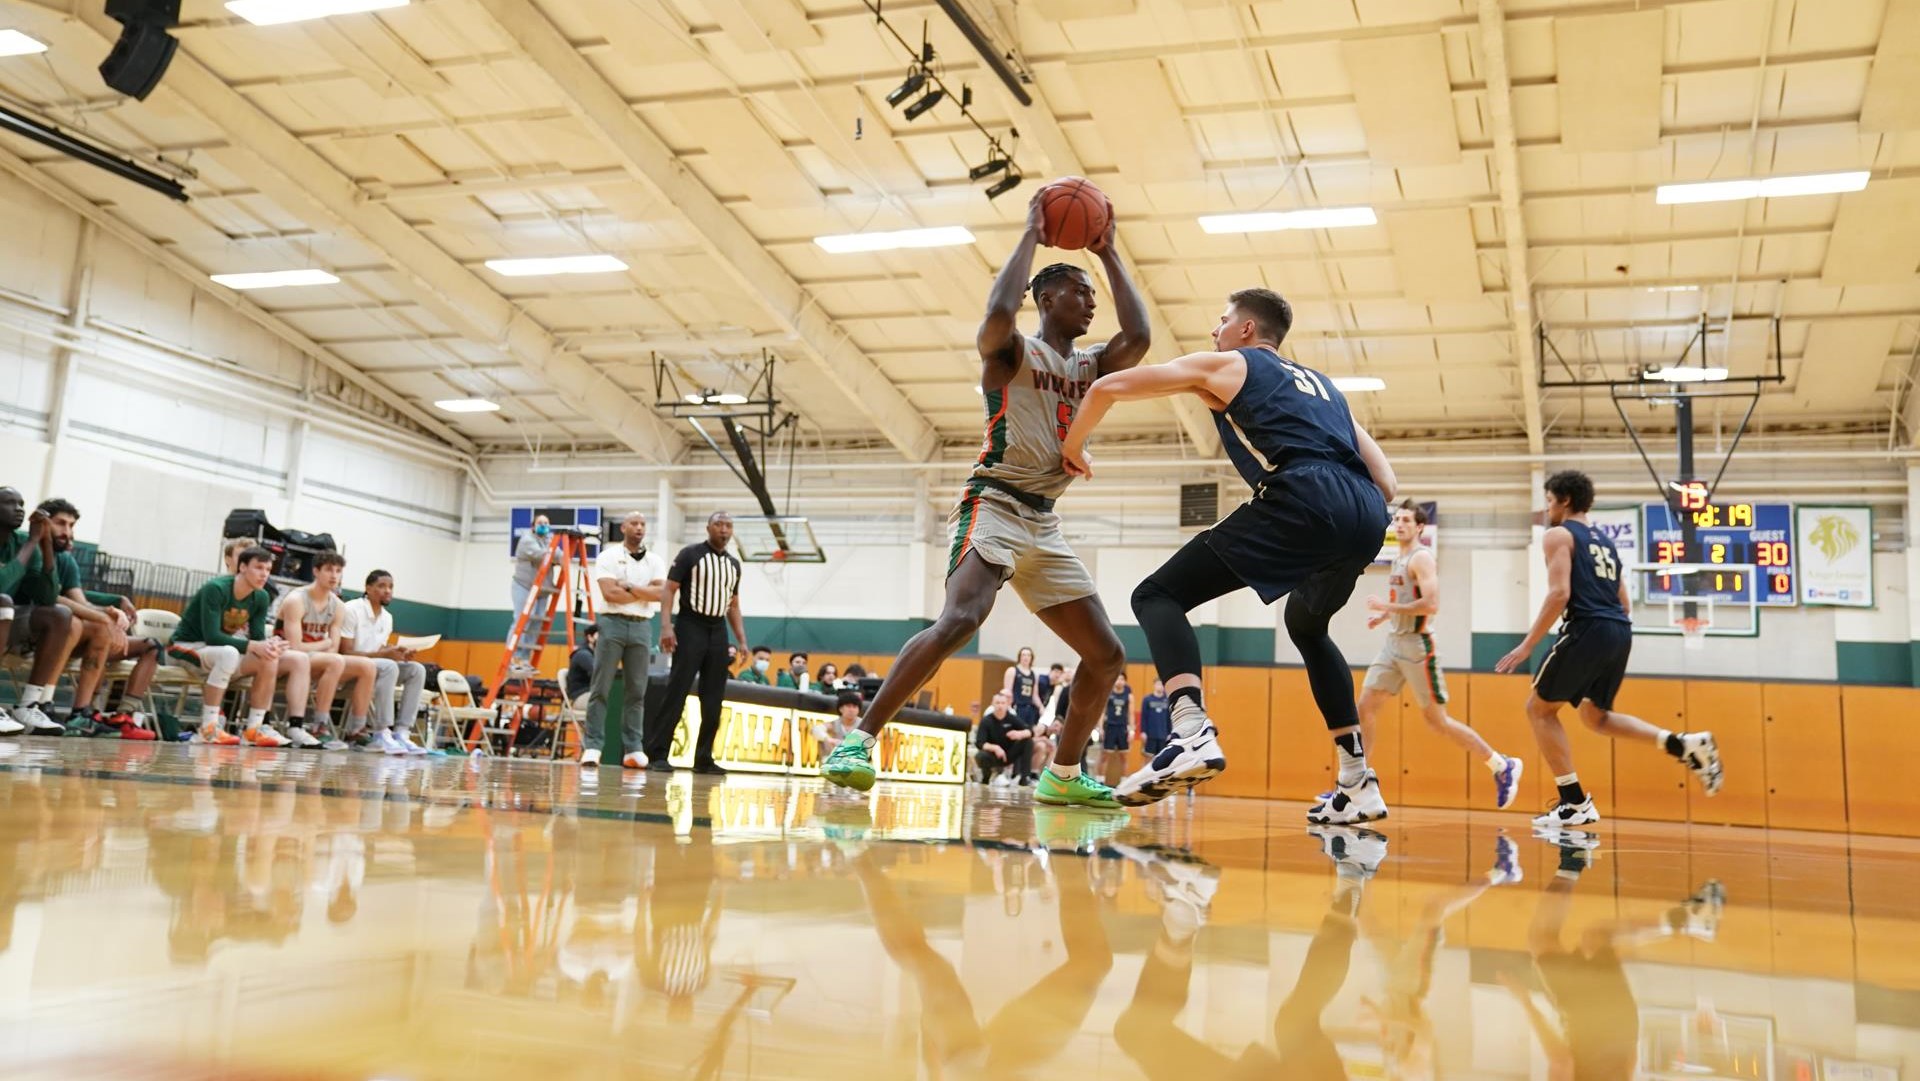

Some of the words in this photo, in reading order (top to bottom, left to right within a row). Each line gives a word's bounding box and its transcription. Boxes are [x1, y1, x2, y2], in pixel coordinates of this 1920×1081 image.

[1280, 362, 1331, 402] 31
[1589, 544, 1617, 581] 35
[1711, 543, 1725, 564] 2
[1757, 542, 1788, 566] 30
[1775, 572, 1789, 594] 0
[880, 726, 944, 775] WOLVES
